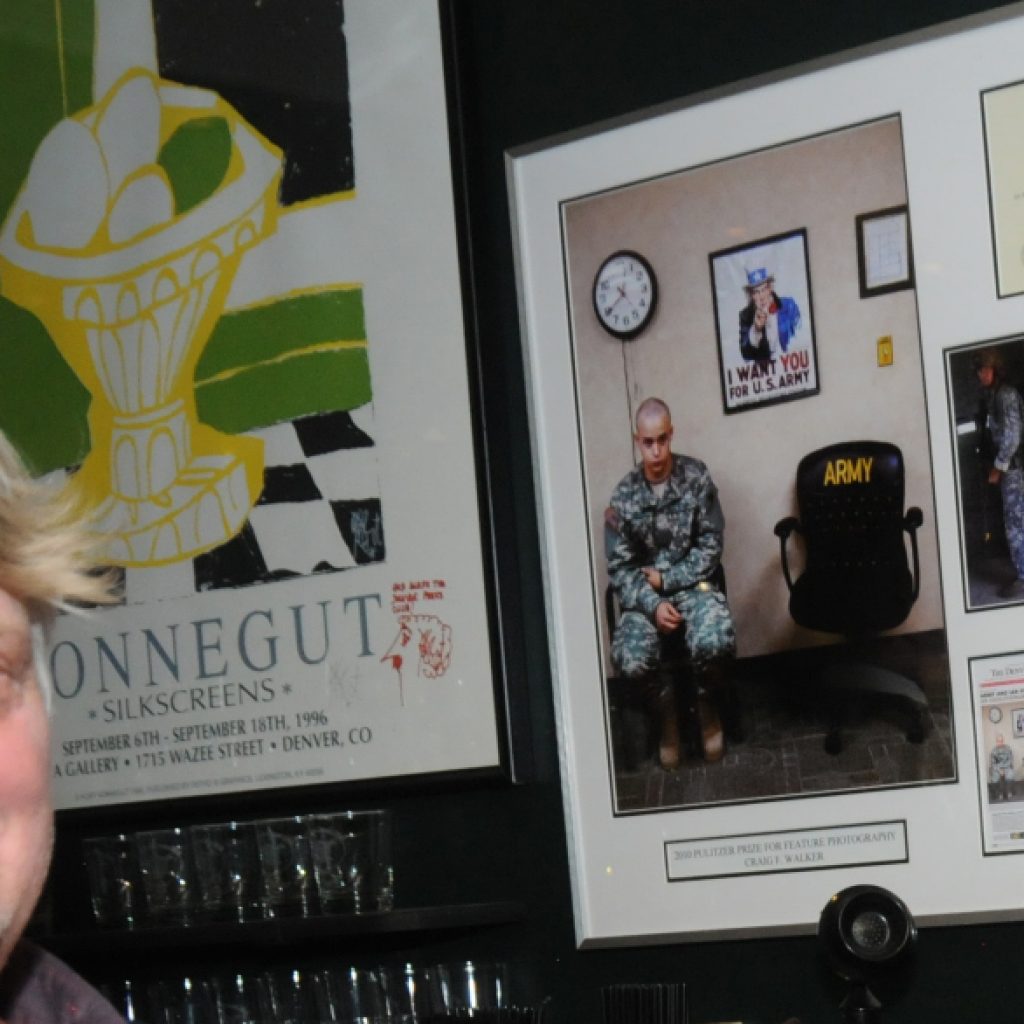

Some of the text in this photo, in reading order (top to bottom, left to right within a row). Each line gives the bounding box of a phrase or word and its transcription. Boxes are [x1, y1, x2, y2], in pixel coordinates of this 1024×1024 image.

[727, 350, 809, 385] I WANT YOU
[729, 384, 749, 400] FOR
[779, 370, 809, 387] ARMY
[824, 457, 873, 487] ARMY
[49, 592, 382, 699] ONNEGUT
[102, 677, 275, 723] SILKSCREENS
[62, 733, 131, 756] SEPTEMBER
[134, 729, 160, 748] 6TH
[172, 719, 246, 743] SEPTEMBER
[251, 714, 291, 734] 18TH,
[295, 709, 329, 728] 1996
[65, 755, 119, 776] GALLERY
[135, 751, 166, 769] 1715
[169, 745, 215, 764] WAZEE
[218, 739, 264, 760] STREET
[282, 730, 344, 752] DENVER,
[348, 726, 373, 745] CO
[783, 837, 825, 850] FEATURE
[827, 831, 896, 847] PHOTOGRAPHY
[785, 851, 824, 863] WALKER
